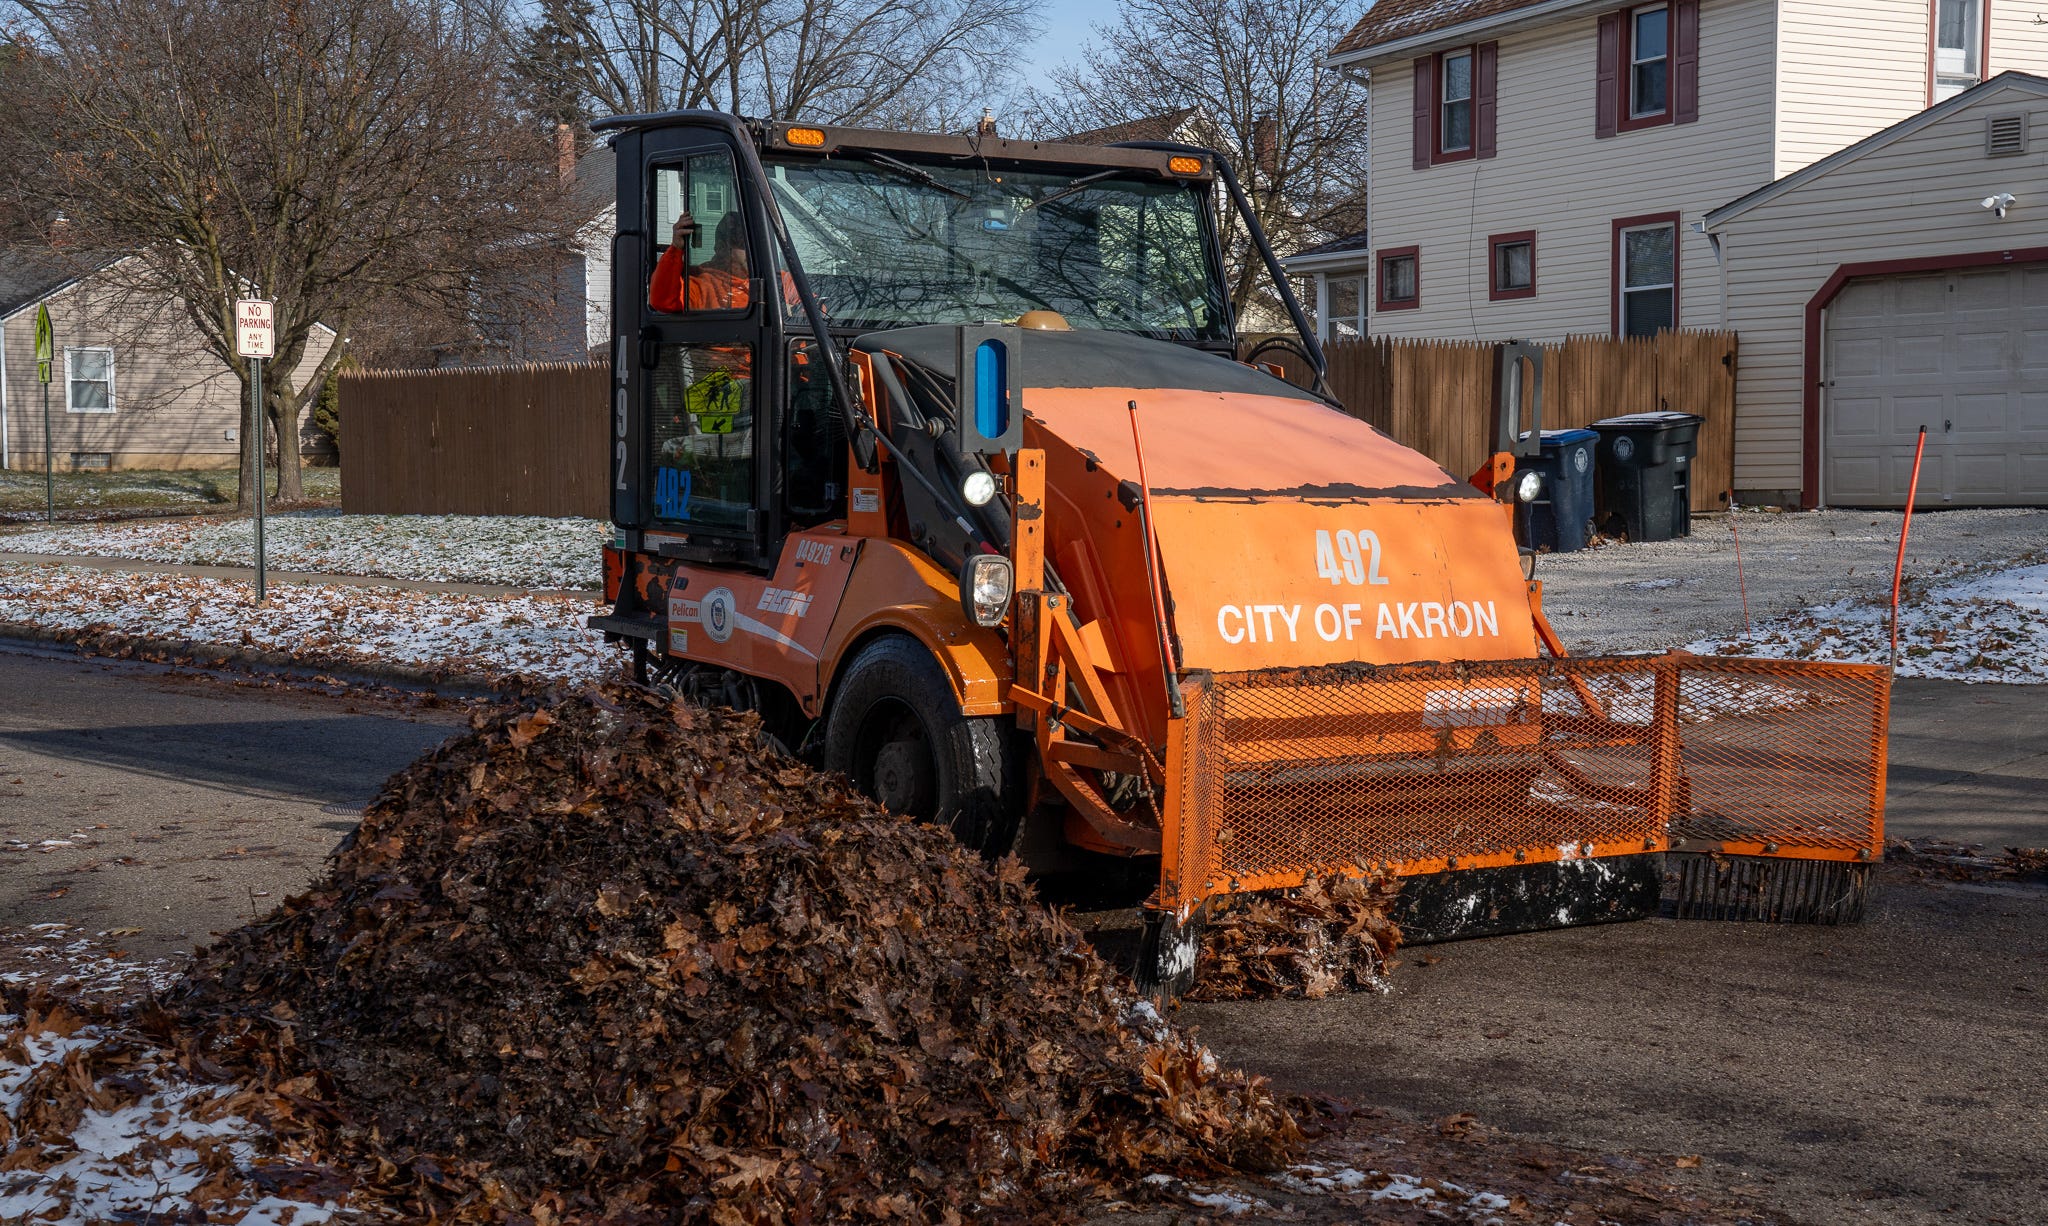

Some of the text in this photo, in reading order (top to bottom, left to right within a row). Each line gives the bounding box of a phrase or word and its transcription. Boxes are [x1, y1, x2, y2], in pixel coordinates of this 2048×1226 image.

[239, 318, 271, 329] PARKING
[248, 306, 262, 316] NO
[247, 341, 264, 349] TIME
[616, 335, 629, 491] 492
[656, 466, 692, 520] 492
[1315, 529, 1389, 585] 492
[671, 602, 699, 617] Pelican
[756, 586, 815, 618] ELGIN
[1217, 600, 1499, 644] CITY OF AKRON
